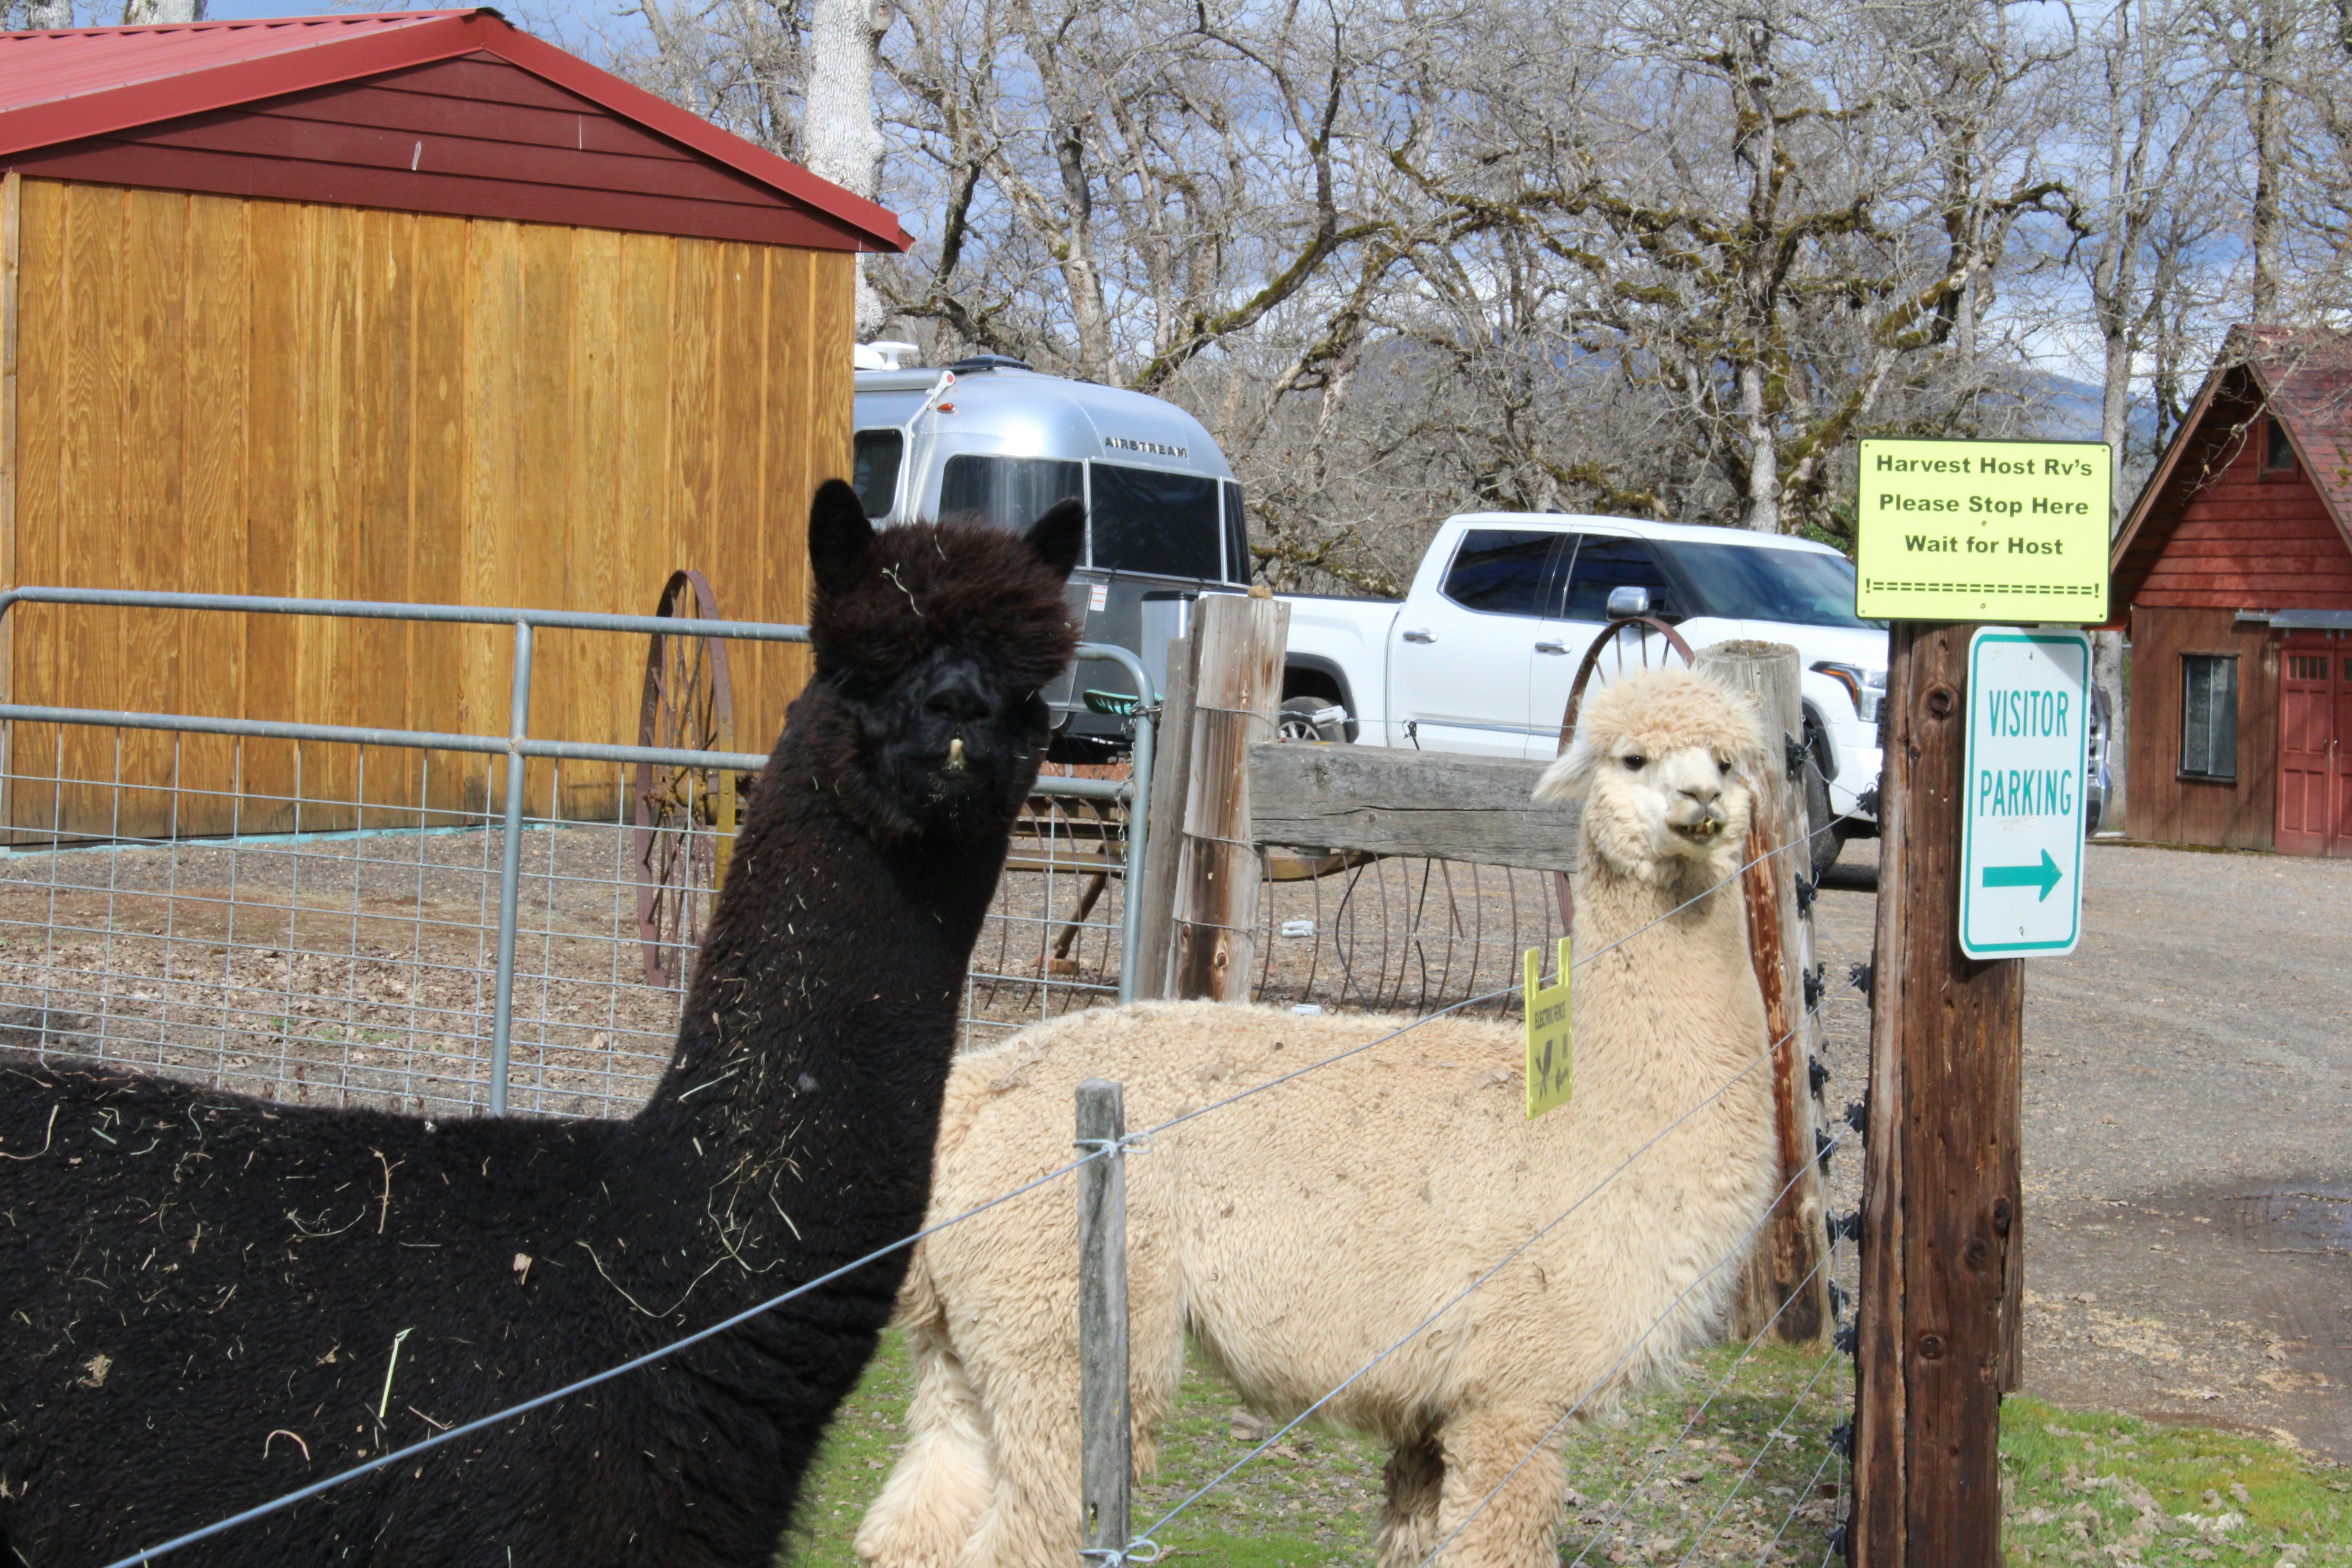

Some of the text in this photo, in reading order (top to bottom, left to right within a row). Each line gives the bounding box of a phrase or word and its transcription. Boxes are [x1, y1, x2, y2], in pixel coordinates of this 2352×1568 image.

[1105, 437, 1187, 458] AIRSTREAM
[1877, 455, 2092, 476] Harvest Host Rv's
[1880, 494, 2089, 517] Please Stop Here
[1905, 535, 2063, 555] Wait for Host
[1989, 690, 2069, 737] VISITOR
[1980, 769, 2072, 816] PARKING
